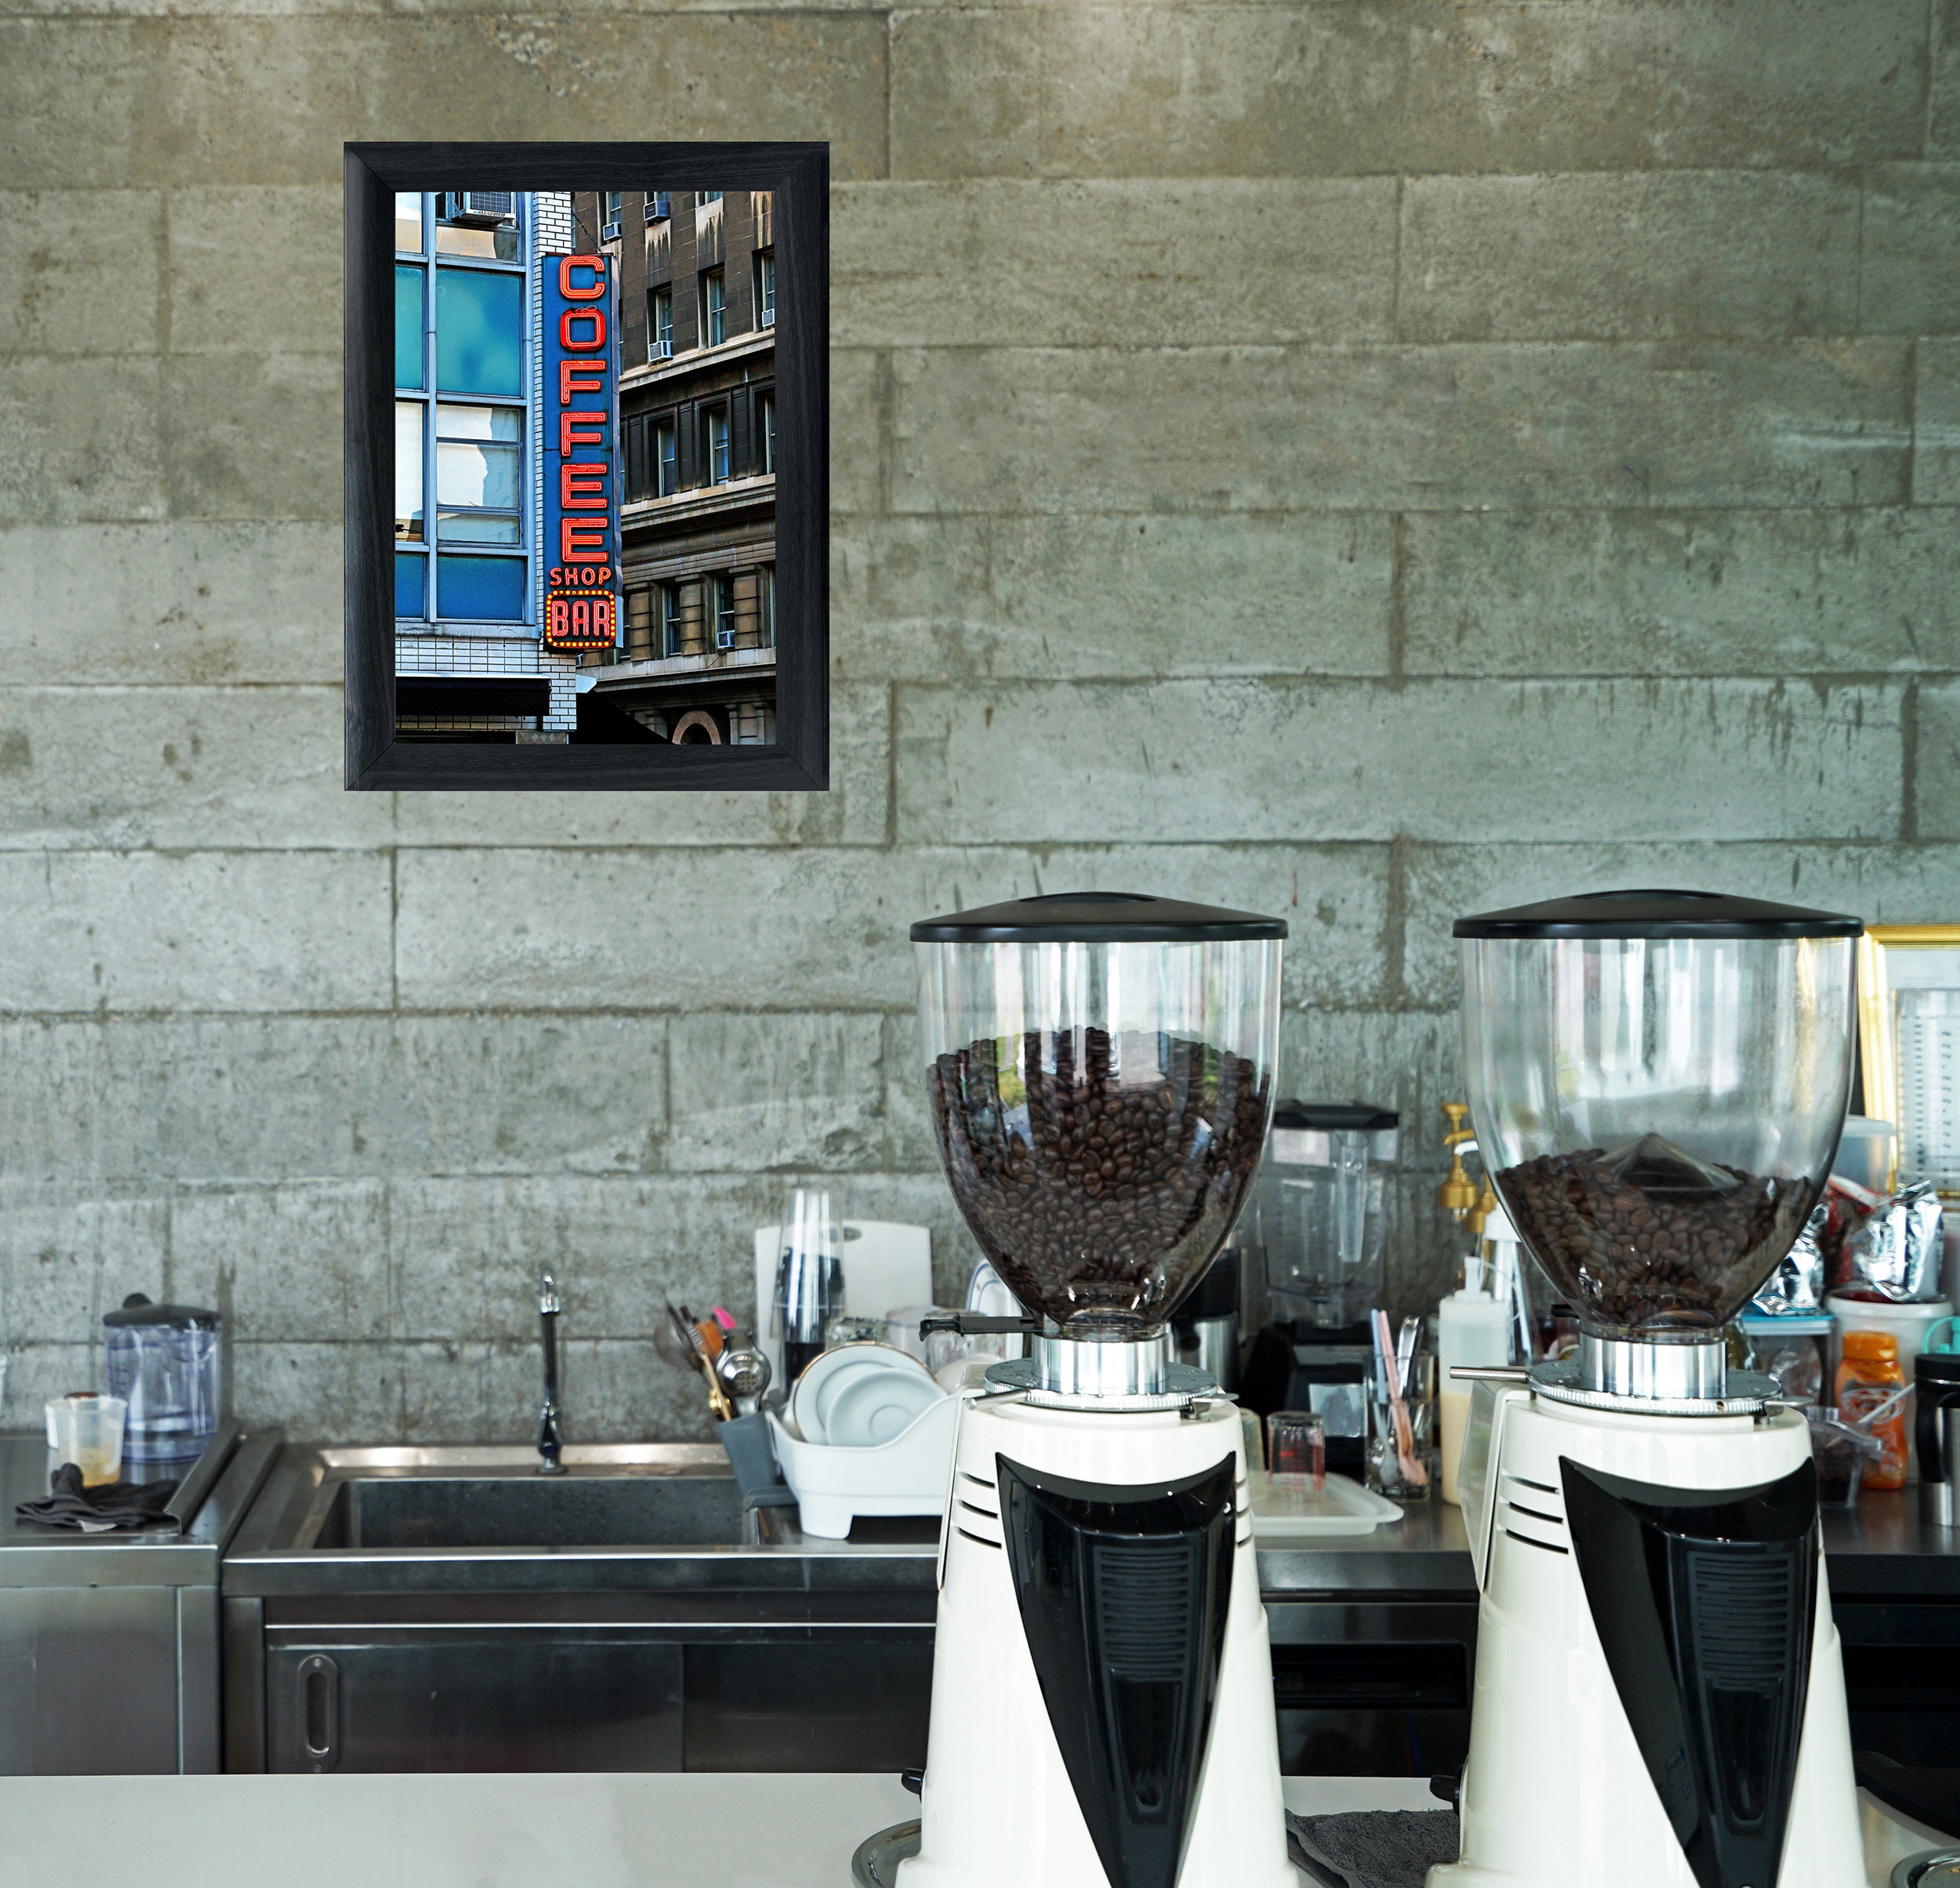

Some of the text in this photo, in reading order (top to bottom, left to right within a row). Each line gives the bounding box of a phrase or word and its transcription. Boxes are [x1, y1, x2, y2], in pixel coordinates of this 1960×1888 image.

[560, 255, 608, 563] COFFEE
[550, 567, 612, 586] SHOP
[551, 599, 610, 637] BAR
